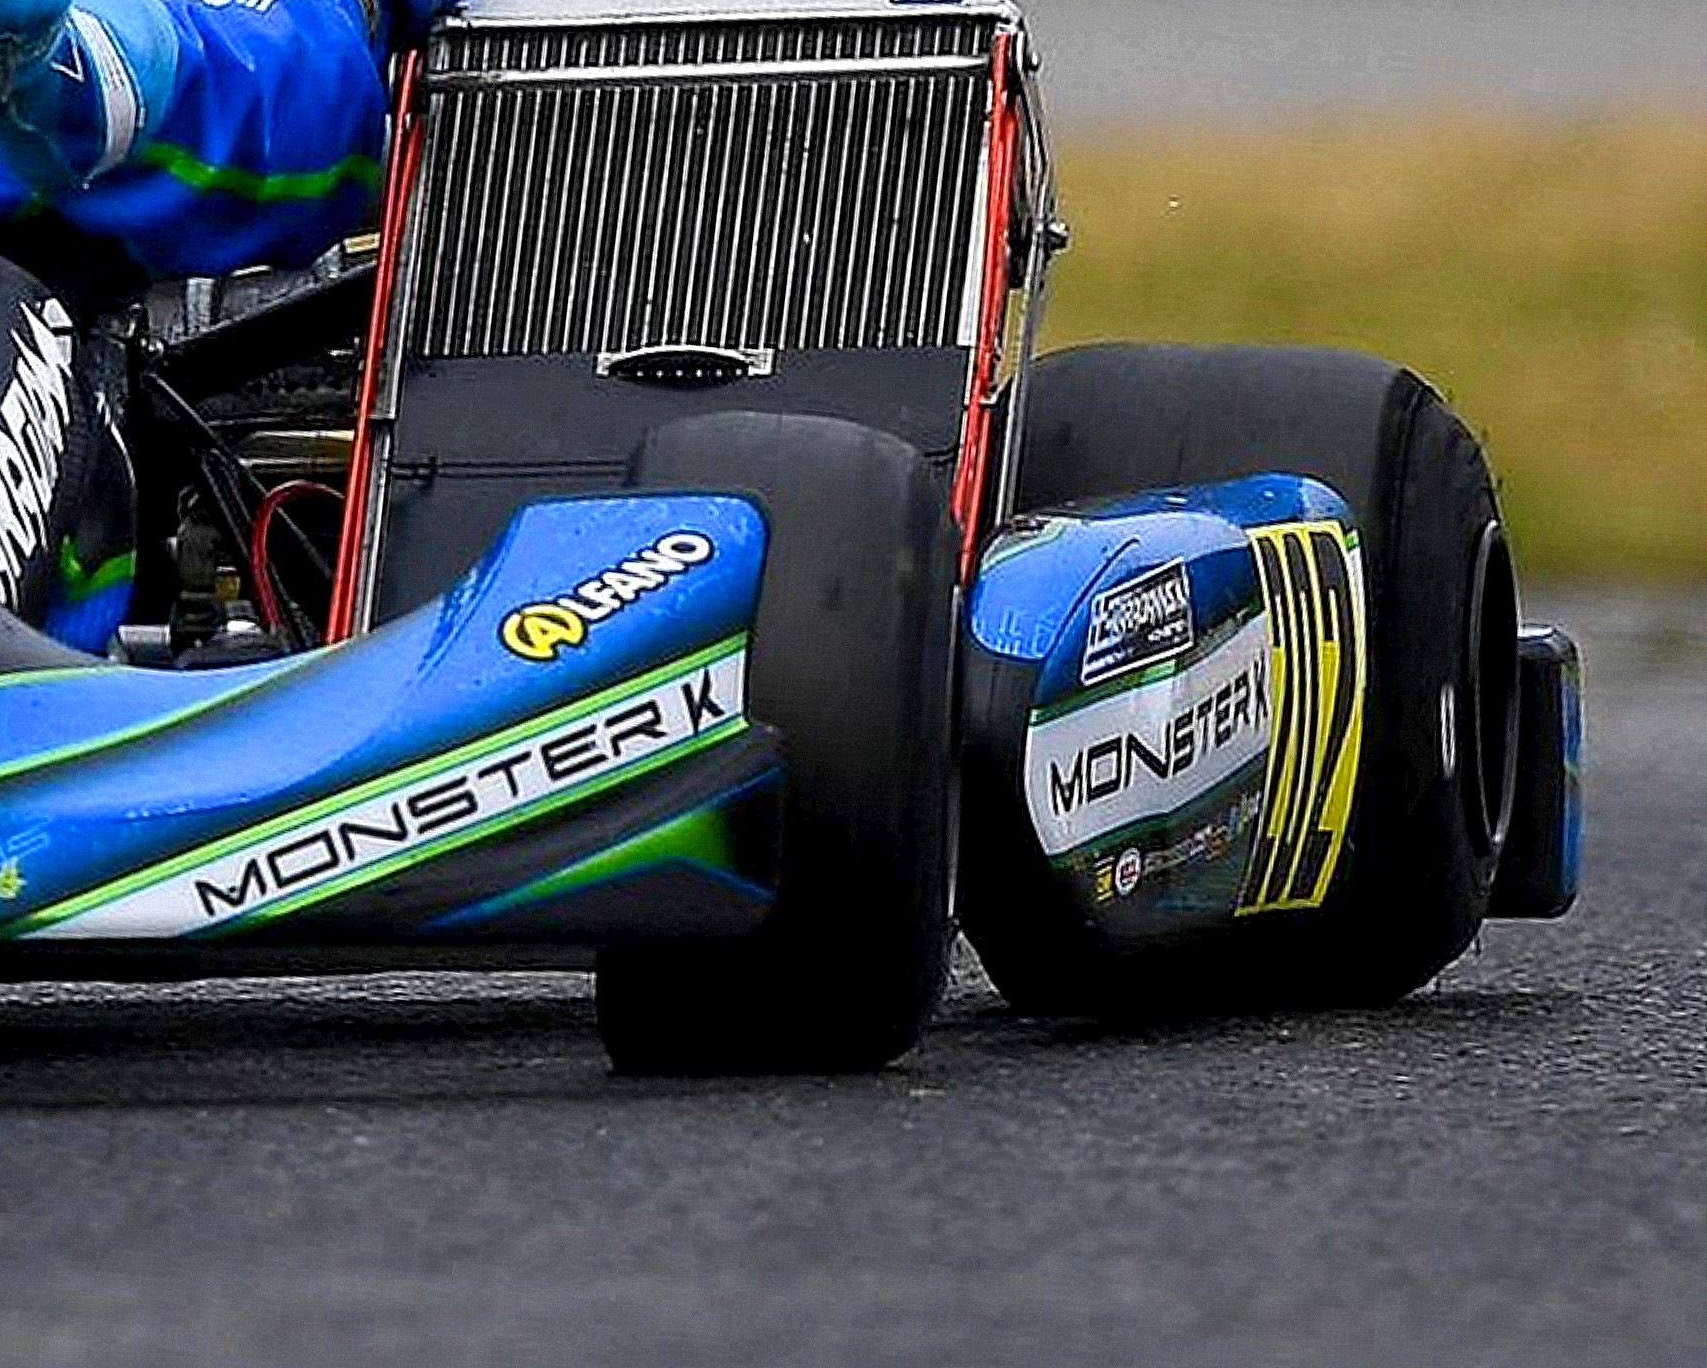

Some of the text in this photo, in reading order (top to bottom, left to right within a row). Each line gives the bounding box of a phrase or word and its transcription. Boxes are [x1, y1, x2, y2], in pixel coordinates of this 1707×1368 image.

[502, 530, 715, 661] ALFANO
[195, 670, 725, 918] MONSTER K
[1049, 670, 1251, 816] MONSTER
